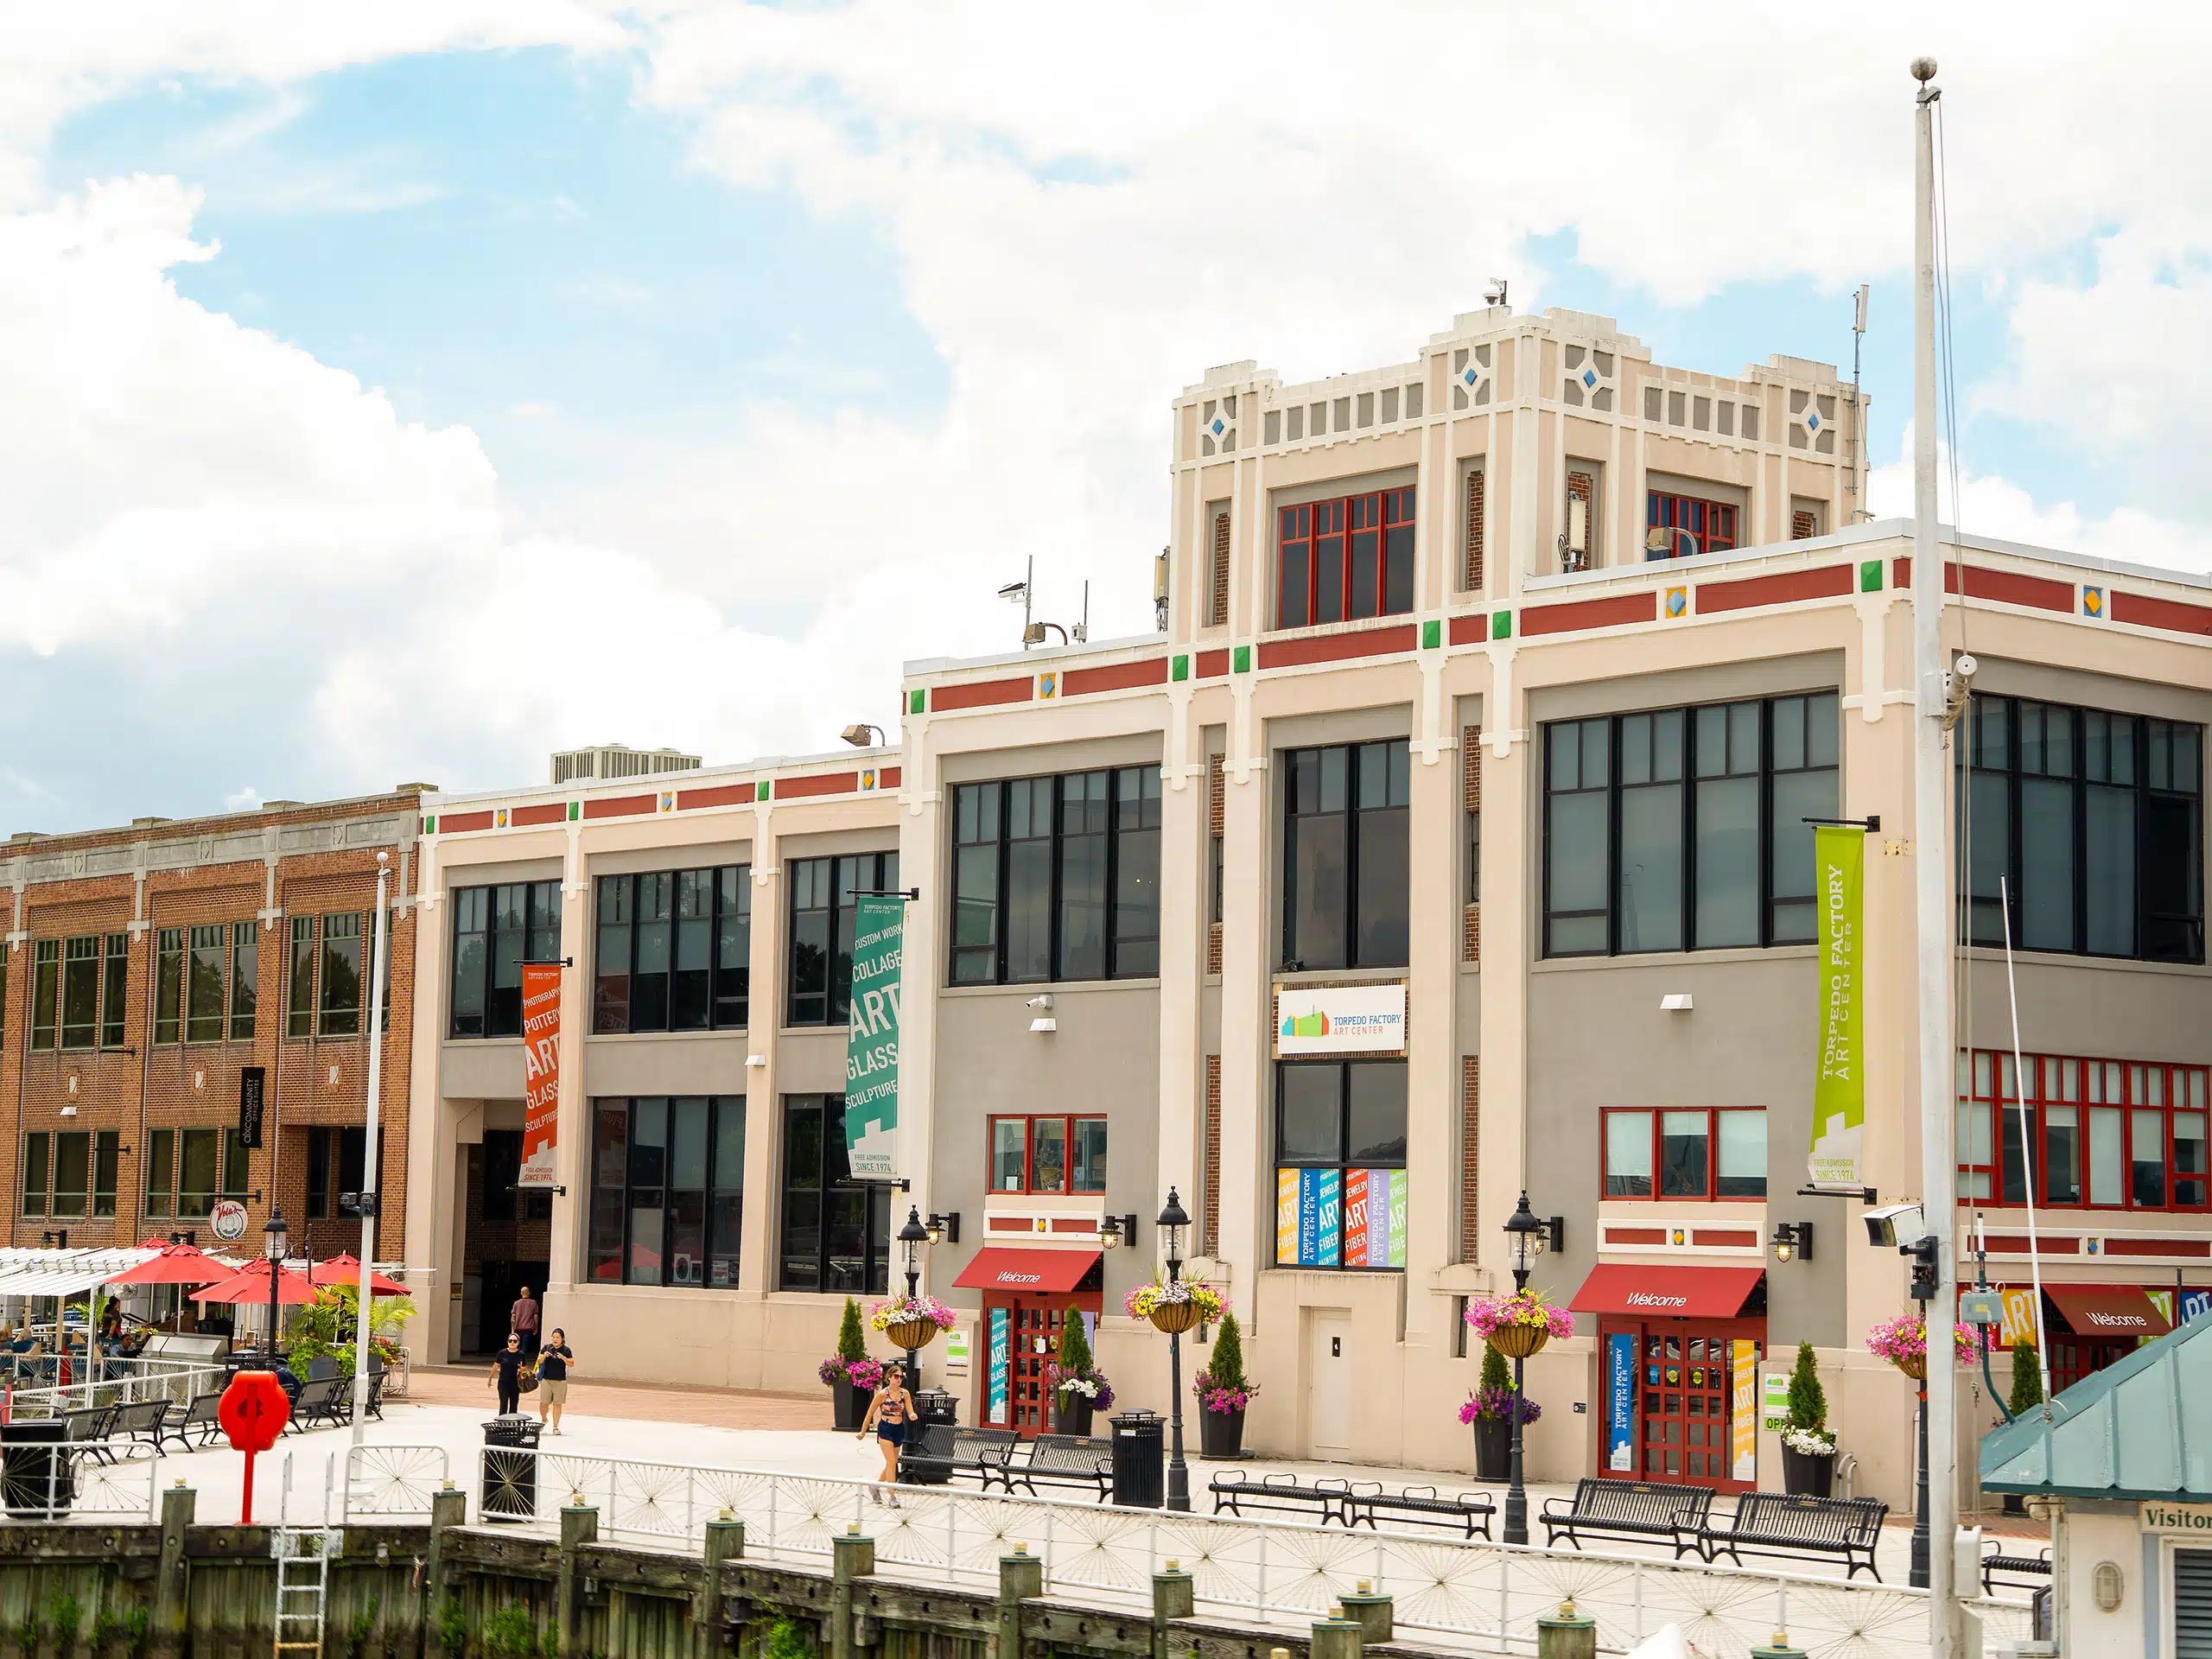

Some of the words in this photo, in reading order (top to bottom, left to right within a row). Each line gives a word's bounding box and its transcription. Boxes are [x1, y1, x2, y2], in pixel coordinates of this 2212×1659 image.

[1827, 864, 1845, 966] FACTORY
[855, 931, 882, 950] CUSTOM
[881, 923, 904, 940] WORK
[852, 949, 903, 982] COLLAGE
[1840, 923, 1853, 1021] CENTER
[849, 981, 900, 1044] ART
[1334, 1016, 1367, 1026] TORPEDO
[1370, 1014, 1402, 1024] FACTORY
[1823, 975, 1842, 1080] TORPEDO
[1351, 1026, 1383, 1034] CENTER
[524, 1032, 561, 1081] ART
[847, 1042, 899, 1081] GLASS
[1836, 1035, 1850, 1080] ART
[525, 1079, 559, 1109] GLASS
[845, 1079, 898, 1109] SCULPTURE
[855, 1162, 874, 1172] SINCE
[876, 1163, 892, 1173] 1974
[1816, 1170, 1835, 1180] SINCE
[1837, 1170, 1854, 1180] 1974
[1345, 1179, 1368, 1199] JEWELRY
[1345, 1198, 1369, 1232] ART
[1389, 1201, 1406, 1233] AR
[1344, 1232, 1368, 1253] FIBER
[996, 1271, 1041, 1283] Welcome
[1625, 1292, 1687, 1307] Welcome
[2000, 1289, 2036, 1344] ART
[2085, 1311, 2147, 1326] Welcome
[991, 1343, 1006, 1368] ART
[1732, 1382, 1755, 1413] ART
[1766, 1418, 1786, 1429] OPE
